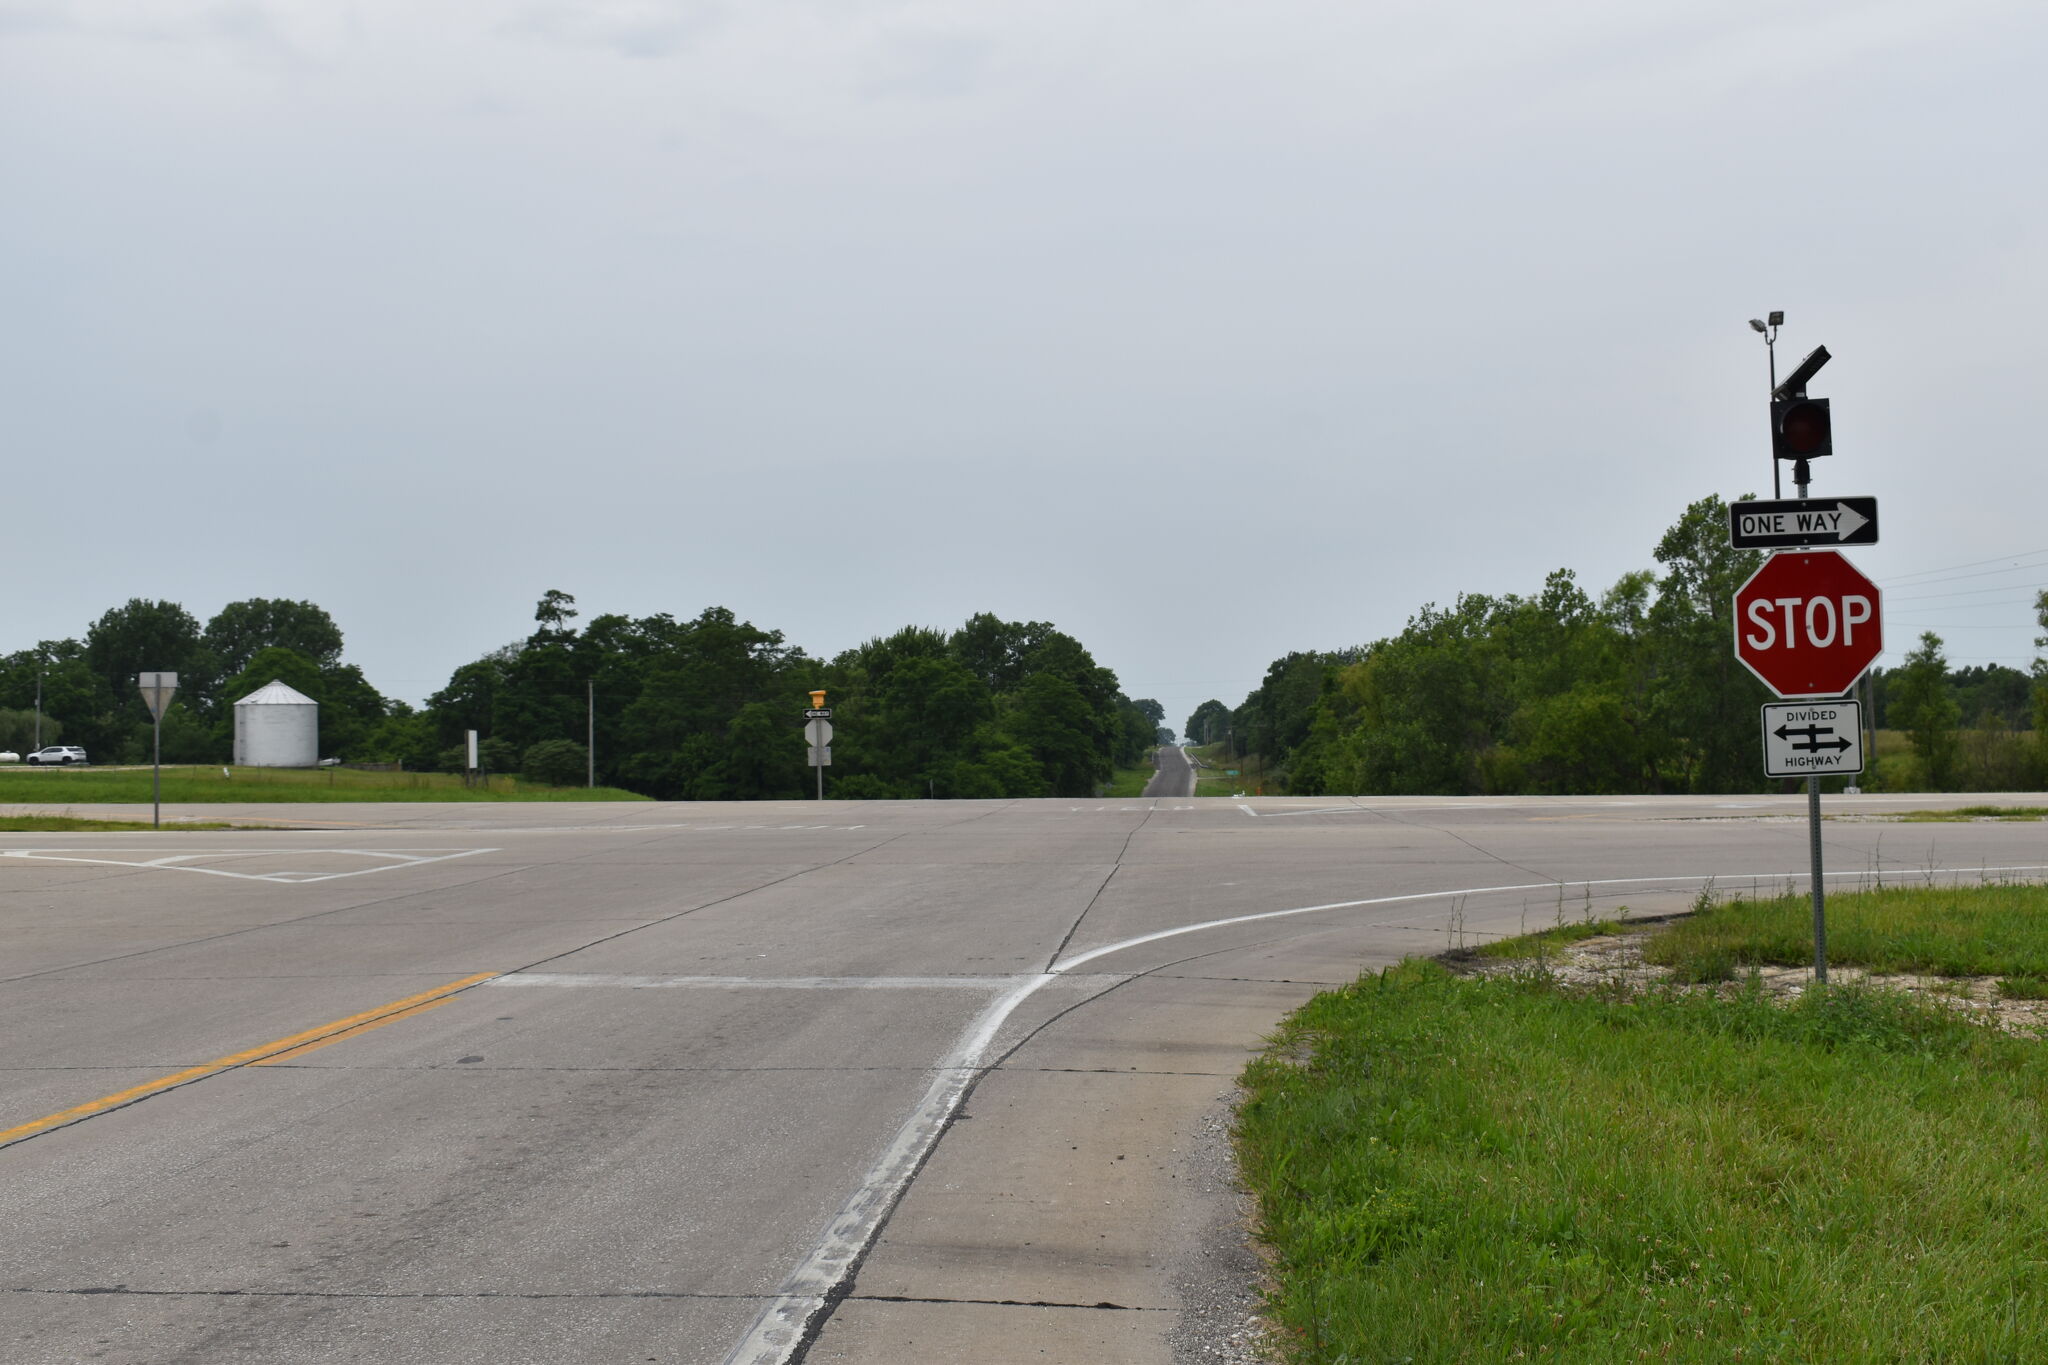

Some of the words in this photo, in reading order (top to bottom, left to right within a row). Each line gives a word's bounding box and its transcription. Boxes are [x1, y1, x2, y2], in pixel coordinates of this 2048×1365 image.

[1742, 515, 1785, 535] ONE
[1797, 512, 1842, 532] WAY
[1746, 594, 1872, 651] STOP
[1786, 710, 1837, 722] DIVIDED
[1785, 755, 1842, 767] HIGHWAY
